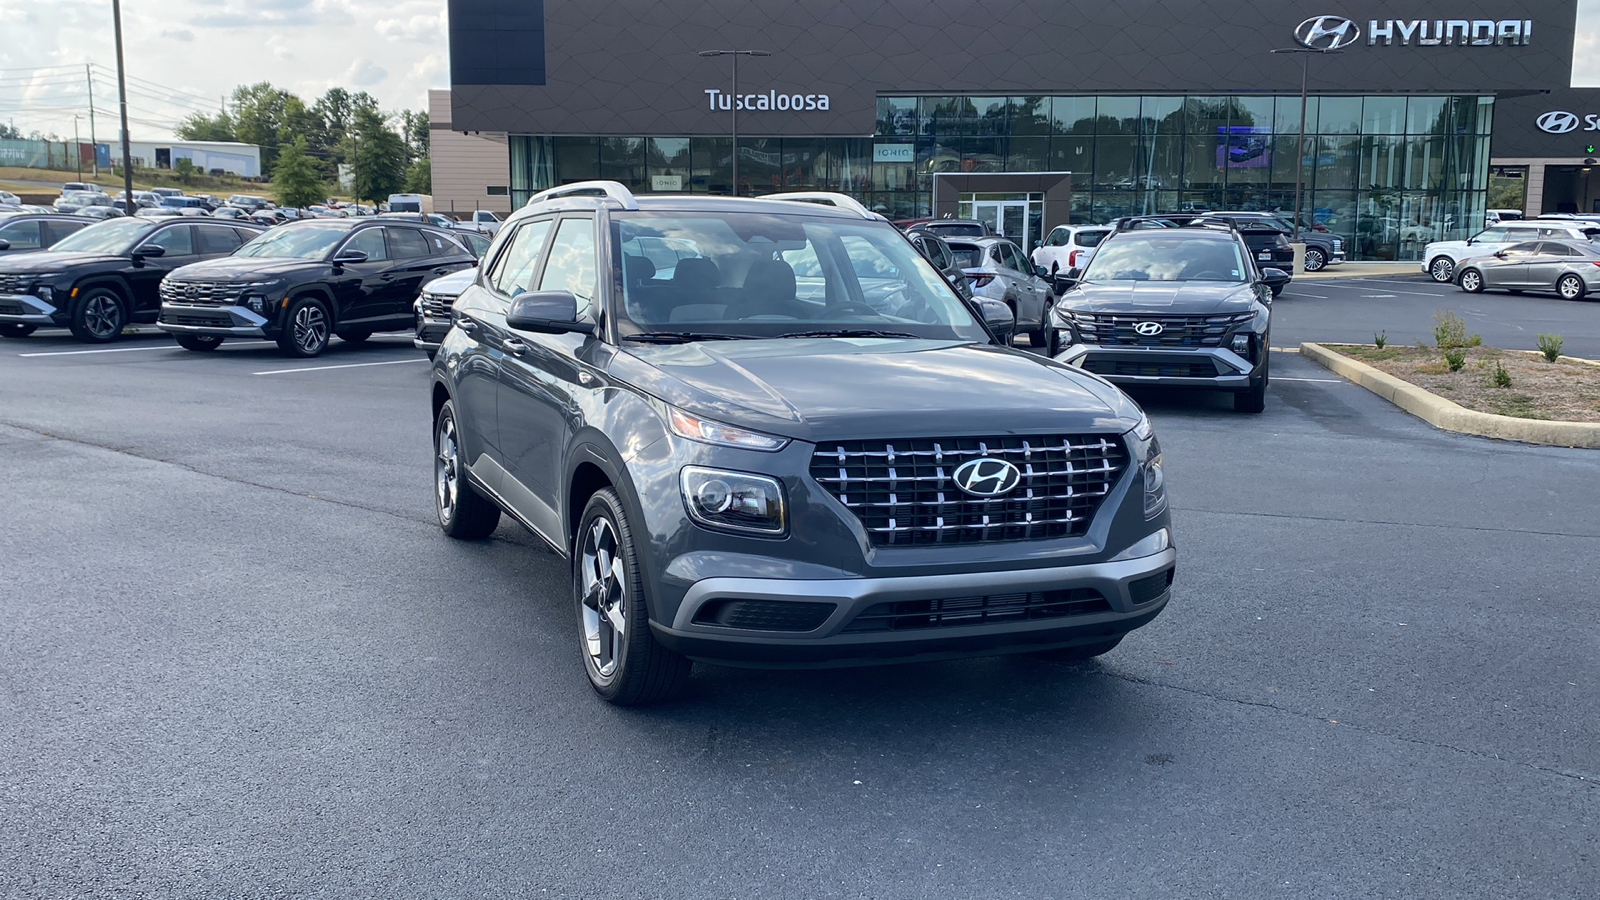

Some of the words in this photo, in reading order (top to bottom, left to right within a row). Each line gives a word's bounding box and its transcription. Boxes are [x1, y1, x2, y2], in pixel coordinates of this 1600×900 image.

[1368, 20, 1532, 46] HYUNDAI
[704, 89, 830, 111] Tuscaloosa
[878, 149, 909, 157] IONIQ
